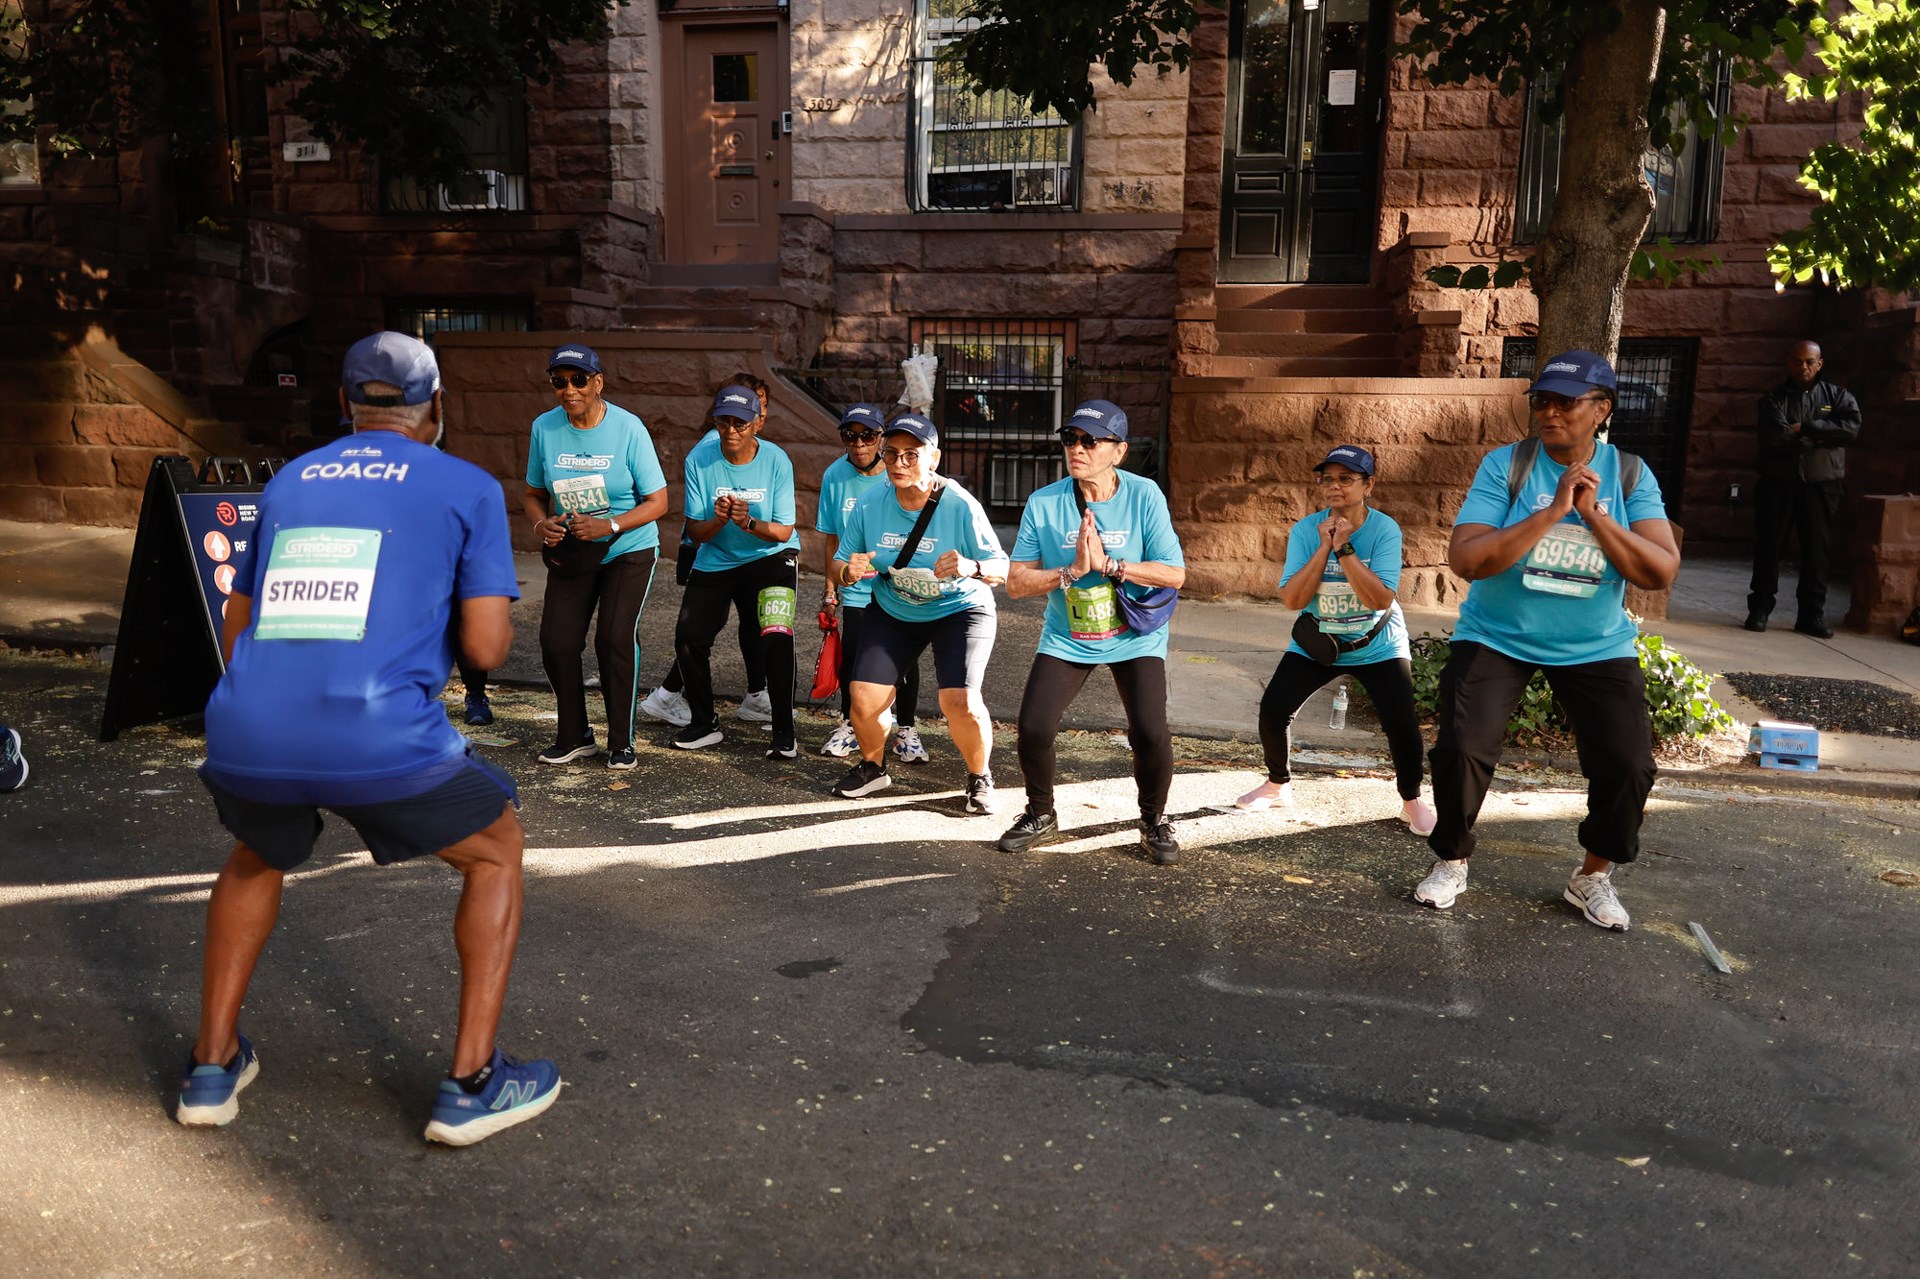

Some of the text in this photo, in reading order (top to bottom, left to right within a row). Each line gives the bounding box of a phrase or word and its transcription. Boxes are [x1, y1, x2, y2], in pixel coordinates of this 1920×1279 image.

[809, 98, 833, 110] 309
[301, 462, 409, 481] COACH
[560, 488, 608, 510] 69541
[234, 541, 247, 552] RF
[1534, 538, 1604, 573] 69540
[268, 580, 359, 602] STRIDER
[894, 576, 940, 597] 69538
[765, 600, 791, 617] 6621
[1072, 600, 1116, 621] L 488
